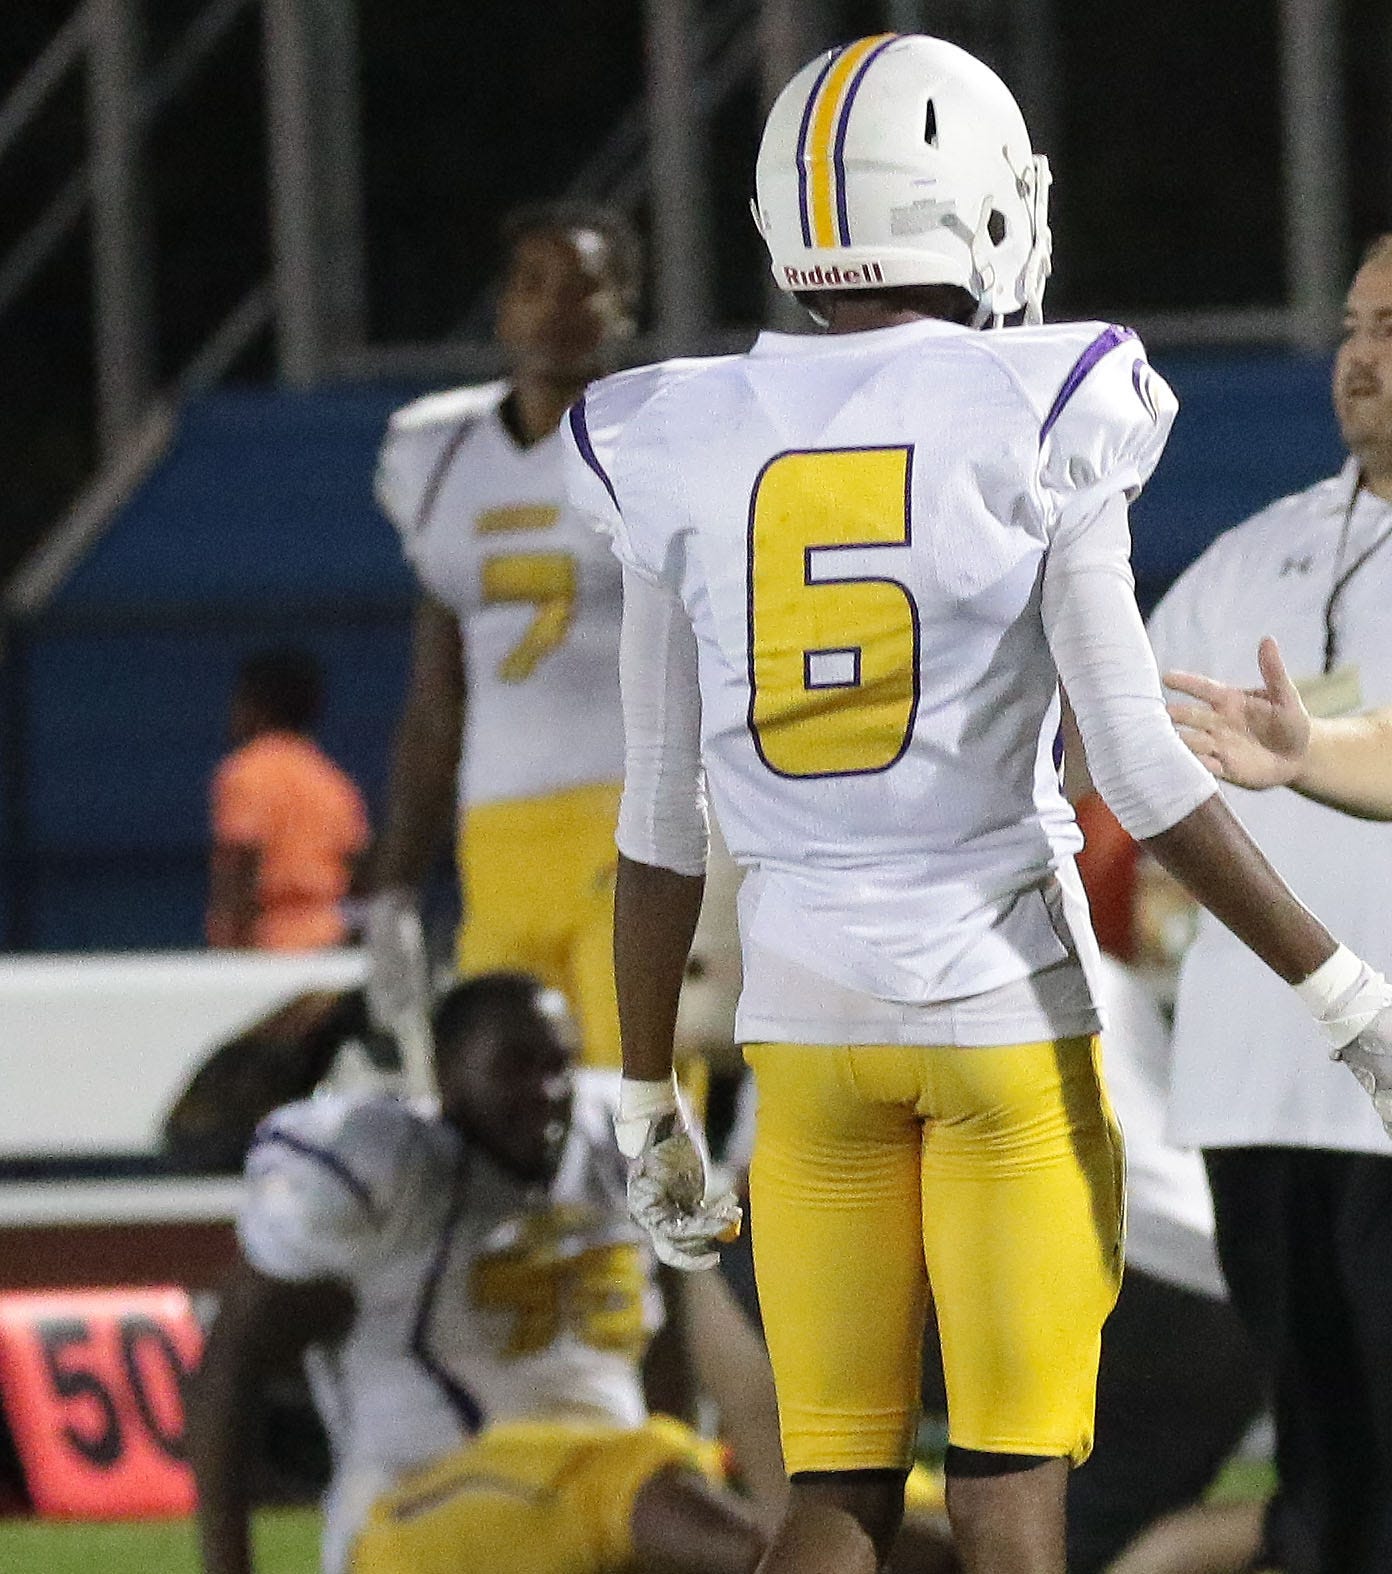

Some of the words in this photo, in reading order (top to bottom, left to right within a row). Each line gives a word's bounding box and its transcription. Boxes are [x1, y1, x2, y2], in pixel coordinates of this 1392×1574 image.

[783, 262, 884, 287] Riddell
[480, 550, 577, 684] 7
[747, 444, 921, 780] 6
[38, 1316, 192, 1468] 50
